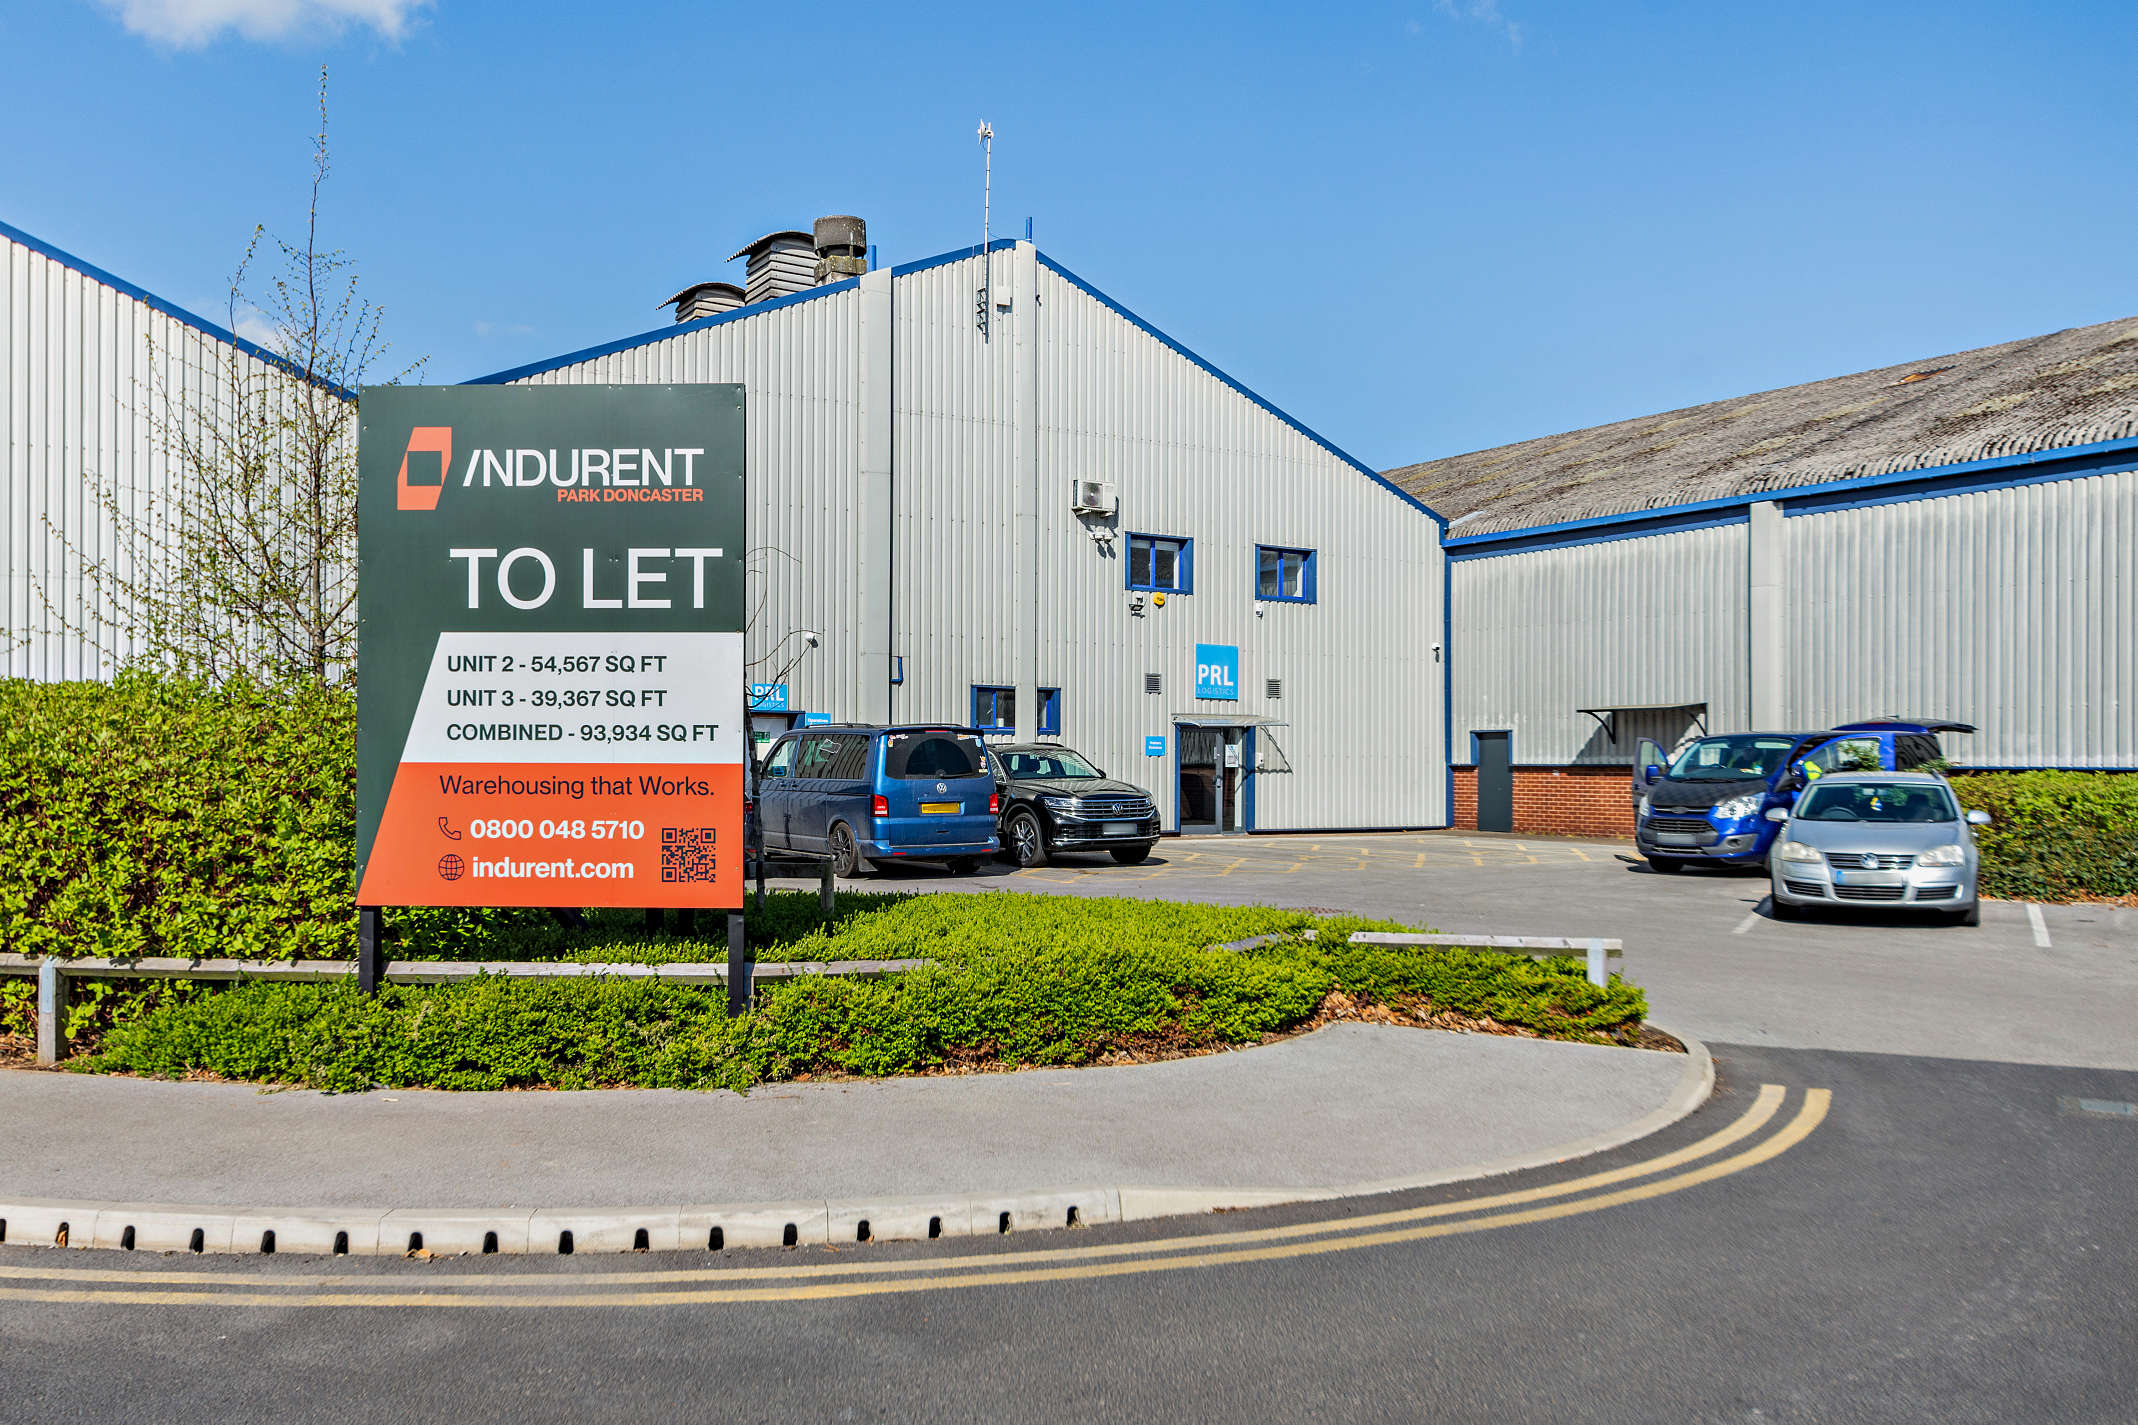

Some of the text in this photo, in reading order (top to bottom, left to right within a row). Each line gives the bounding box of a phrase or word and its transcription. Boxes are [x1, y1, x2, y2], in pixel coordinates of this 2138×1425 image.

[557, 488, 704, 502] PARK DONCASTER
[449, 547, 723, 609] TO LET
[447, 655, 497, 673] UNIT
[501, 655, 514, 673] 2
[530, 655, 600, 676] 54,567
[605, 655, 635, 674] SQ
[640, 655, 667, 673] FT
[1198, 664, 1234, 686] PRL
[447, 689, 497, 707] UNIT
[501, 689, 514, 707] 3
[530, 689, 600, 710] 39,367
[605, 689, 635, 708] SQ
[640, 689, 667, 707] FT
[754, 686, 784, 701] PRL
[1197, 687, 1235, 696] LOGISTICS
[446, 723, 563, 741] COMBINED
[580, 724, 651, 745] 93,934
[656, 724, 688, 743] SQ
[692, 724, 719, 742] FT
[439, 775, 715, 800] Warehousing that Works.
[470, 819, 645, 840] 0800 048 5710
[472, 856, 634, 879] indurent.com
